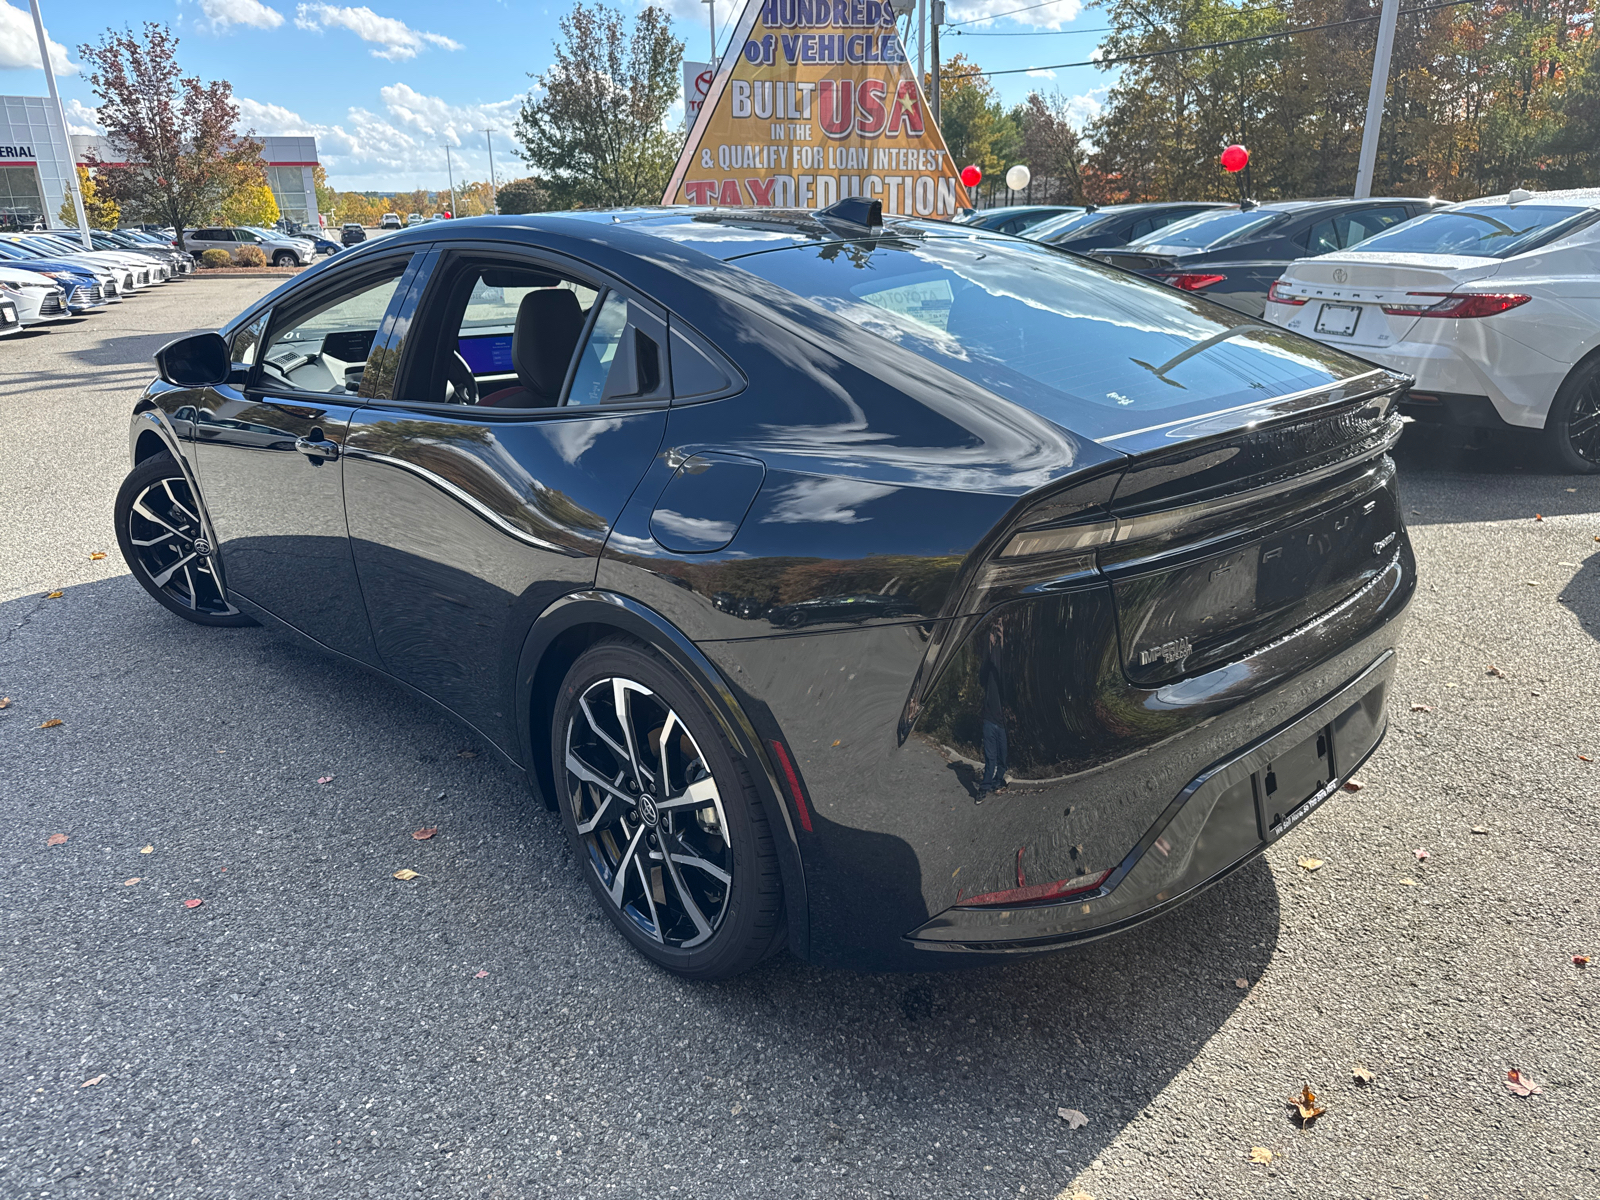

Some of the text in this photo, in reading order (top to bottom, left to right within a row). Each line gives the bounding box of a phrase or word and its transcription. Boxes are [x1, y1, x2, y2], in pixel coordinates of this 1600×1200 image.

[762, 0, 896, 28] HUNDREDS
[744, 33, 777, 66] of
[731, 79, 925, 138] BUILT USA
[770, 123, 812, 141] IN THE
[0, 146, 36, 158] ERIAL
[700, 144, 946, 171] & QUALIFY FOR LOAN INTEREST
[684, 177, 777, 206] TAX
[1139, 636, 1190, 666] IMPERIAL
[1165, 644, 1193, 664] cars.com
